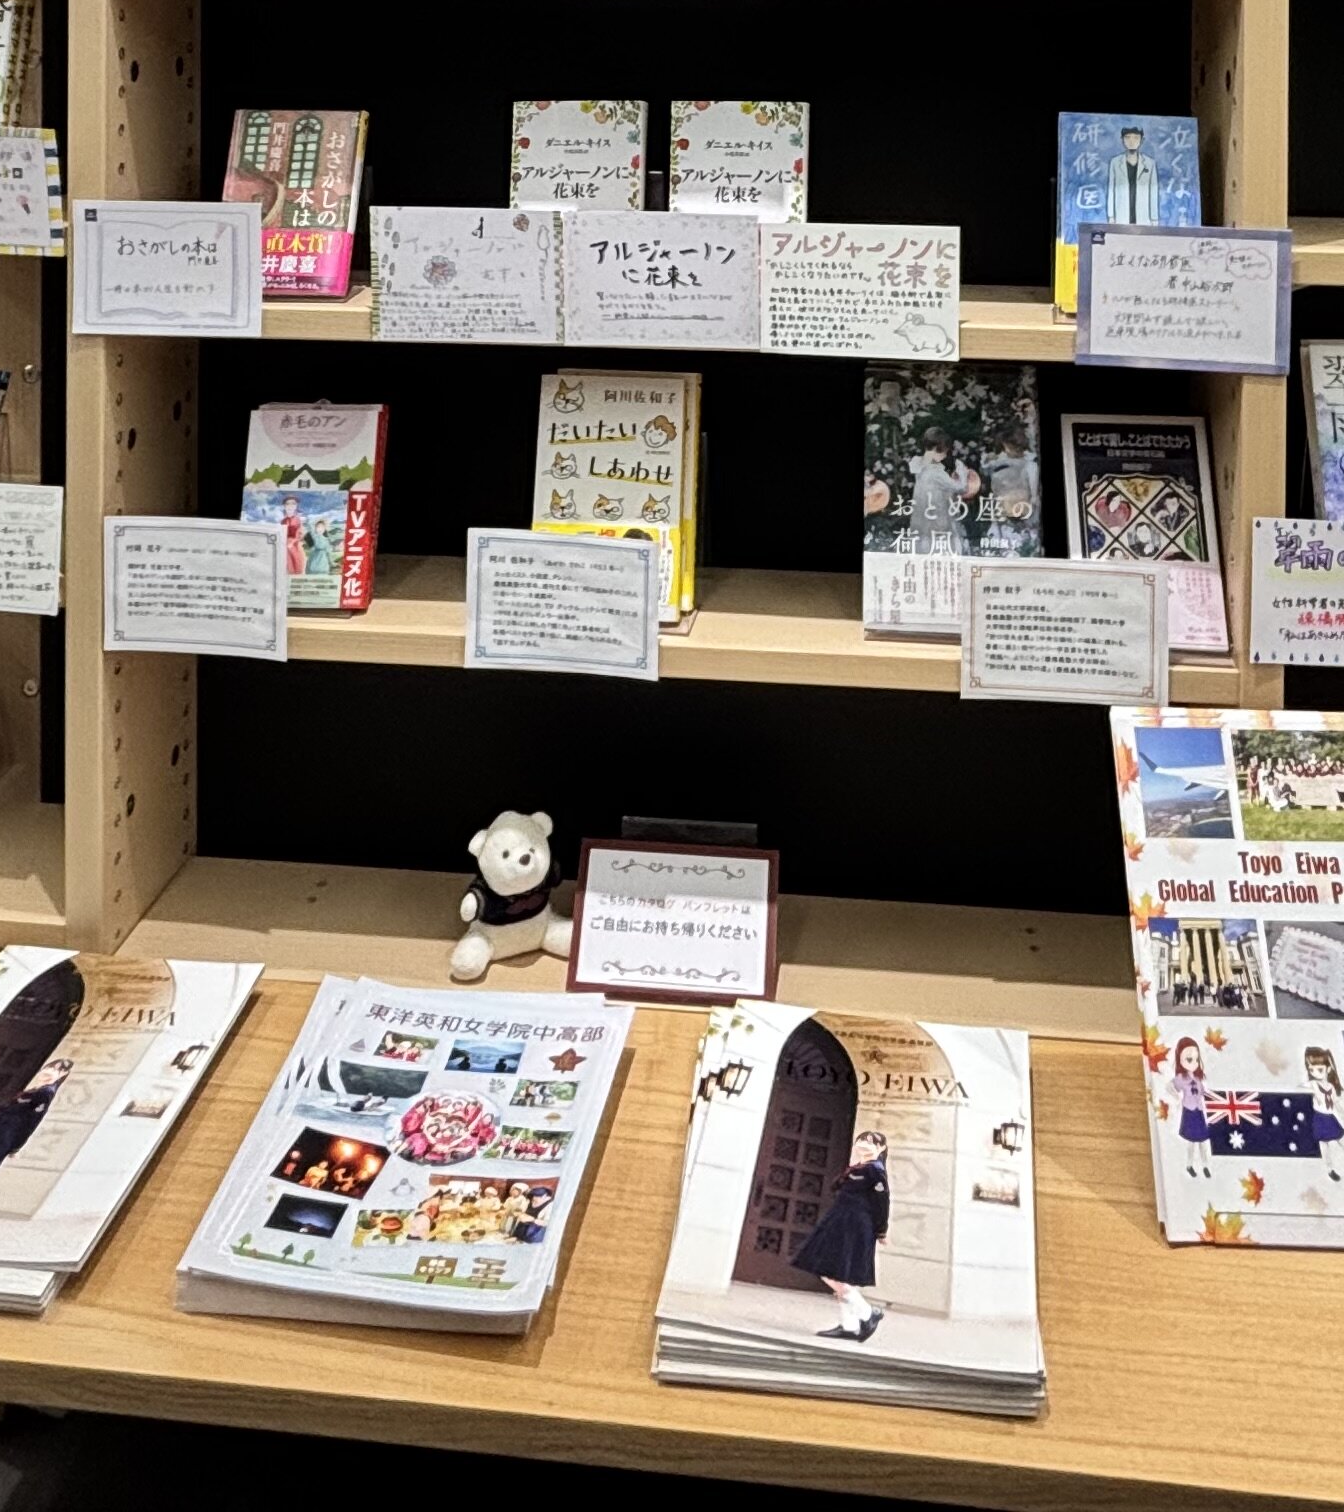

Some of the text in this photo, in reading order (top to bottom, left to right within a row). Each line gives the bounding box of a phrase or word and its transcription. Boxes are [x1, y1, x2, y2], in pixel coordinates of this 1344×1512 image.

[522, 163, 630, 181] アルジャーノンに
[681, 166, 793, 184] アルジャーノンに
[1071, 122, 1104, 210] 研修医
[1157, 124, 1193, 200] 泣くな
[317, 131, 347, 226] おさがしの
[553, 182, 600, 199] 花束を
[292, 188, 315, 227] 本は
[714, 187, 762, 204] 花束を
[117, 235, 217, 256] おさがしの本は
[590, 239, 736, 265] アルジャーノン
[771, 231, 957, 261] アルジャーノンに
[877, 261, 952, 288] 花束を
[280, 414, 348, 430] 赤毛のアン
[548, 420, 638, 444] だいたい
[588, 455, 674, 482] しあわせ
[891, 495, 1033, 522] おとめ座の
[342, 494, 369, 597] TVアニメ化
[889, 528, 957, 557] 荷風
[1238, 851, 1341, 876] Toyo Eiwa
[1158, 879, 1216, 902] Global
[1229, 880, 1319, 904] Education
[590, 916, 758, 941] ご自由にお持ち帰りください
[364, 1002, 607, 1043] 東洋英和女学院中高部
[884, 1073, 970, 1100] EIWA
